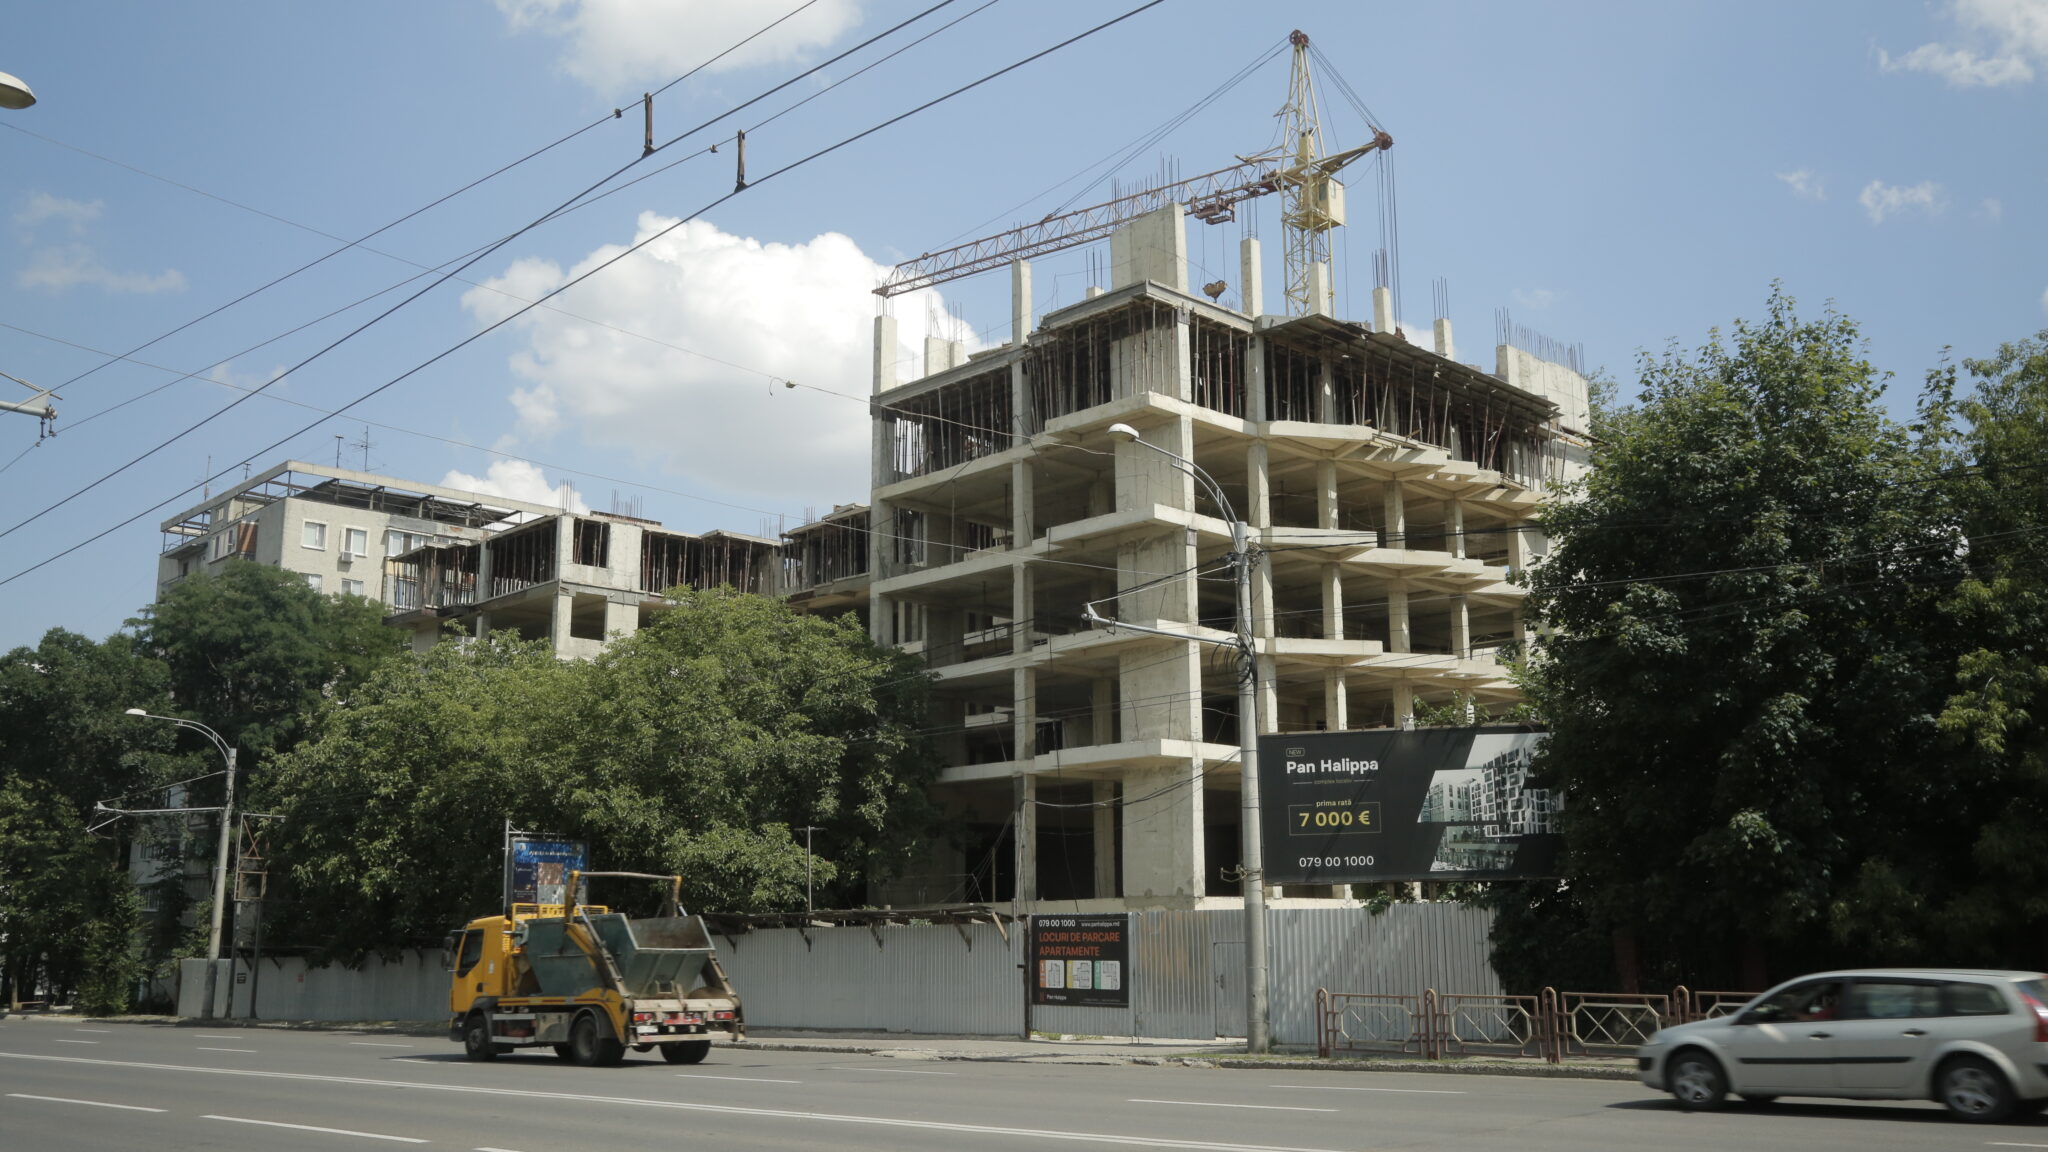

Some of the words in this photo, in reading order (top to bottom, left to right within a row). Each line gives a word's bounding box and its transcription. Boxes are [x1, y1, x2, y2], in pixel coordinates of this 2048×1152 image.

[1286, 761, 1316, 774] Pan
[1320, 758, 1379, 775] Halippa
[1316, 800, 1336, 809] prima
[1337, 798, 1352, 807] rată
[1298, 812, 1310, 827] 7
[1315, 810, 1353, 827] 000
[1358, 810, 1371, 825] €
[1298, 857, 1322, 868] 079
[1324, 856, 1341, 867] 00
[1344, 855, 1375, 867] 1000
[1038, 919, 1050, 928] 079
[1050, 919, 1060, 928] 00
[1060, 919, 1076, 928] 1000
[1039, 932, 1069, 942] LOCURI
[1070, 932, 1081, 942] DE
[1082, 932, 1121, 942] PARCARE
[1039, 946, 1101, 956] APARTAMENTE
